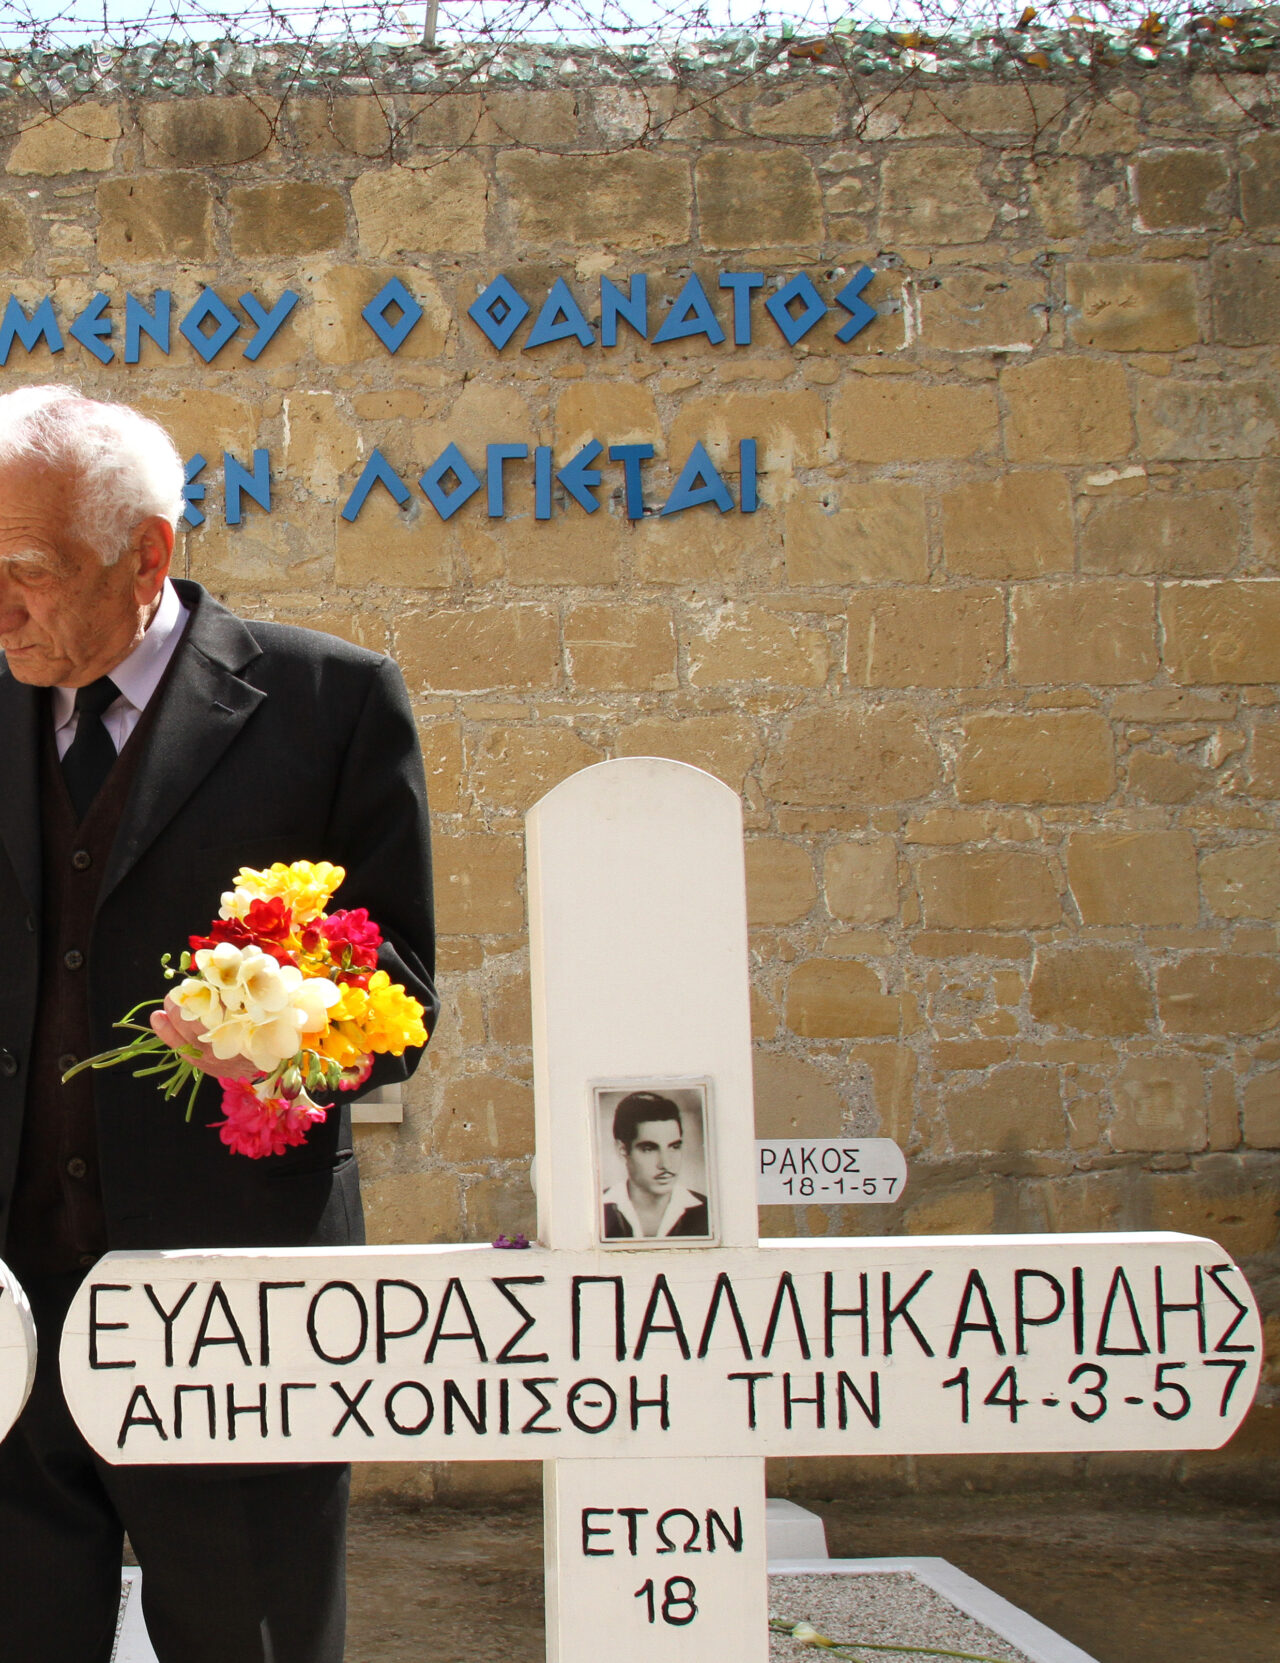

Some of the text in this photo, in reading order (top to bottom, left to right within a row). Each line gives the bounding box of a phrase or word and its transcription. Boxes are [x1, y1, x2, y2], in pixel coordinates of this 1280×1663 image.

[361, 276, 422, 354] Ο
[467, 265, 878, 351] ΘΑΝΑΤΟΣ
[341, 438, 757, 523] ΛΟΓΙΕΤΑΙ
[761, 1148, 861, 1175] ΡΑΚΟΣ
[782, 1177, 898, 1196] 18-1-57
[89, 1265, 1254, 1370] ΕΥΑΓΟΡΑΣ ΠΑΛΛΗΚΑΡΙΔΗΣ
[118, 1360, 1246, 1448] ΑΠΗΓΧΟΝΙΣΘΗ ΤΗΝ 14-3-57
[582, 1506, 743, 1556] ΕΤΩΝ
[634, 1576, 699, 1626] 18
